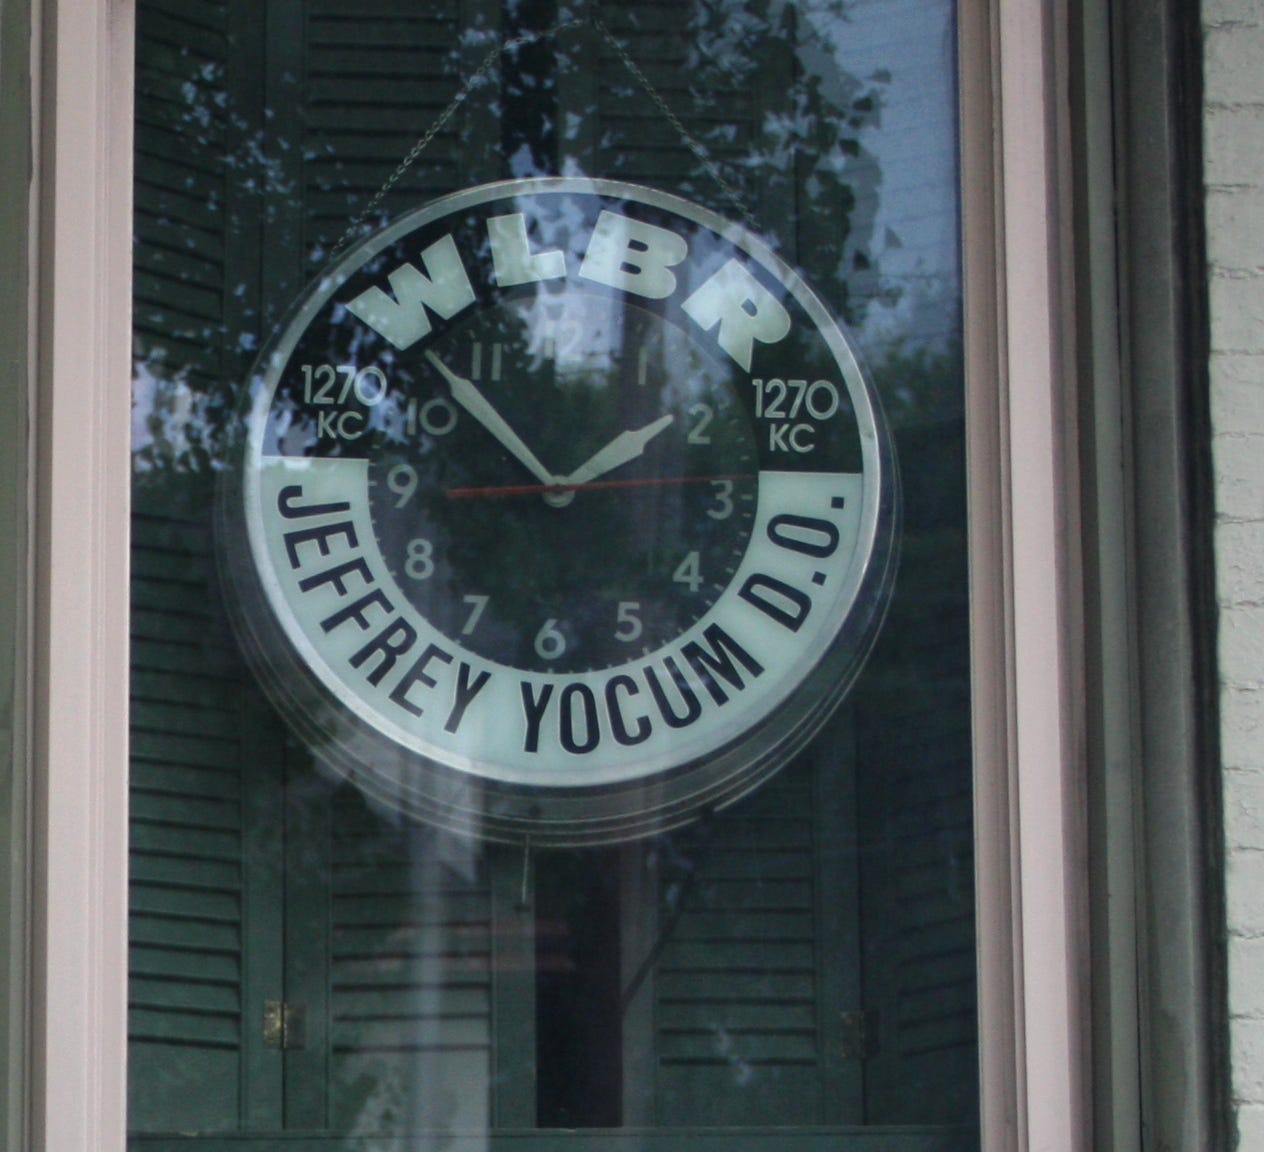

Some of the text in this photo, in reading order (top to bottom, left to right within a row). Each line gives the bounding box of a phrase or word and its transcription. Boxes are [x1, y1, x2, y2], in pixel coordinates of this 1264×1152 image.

[344, 210, 792, 373] WLBR
[301, 364, 387, 405] 1270
[751, 378, 839, 420] 1270
[318, 411, 363, 440] KC
[404, 397, 458, 435] 10
[687, 404, 713, 446] 2
[768, 423, 816, 453] KC
[386, 463, 419, 509] 9
[708, 478, 734, 520] 3
[404, 539, 434, 580] 8
[672, 551, 704, 592] 4
[277, 484, 846, 755] JEFFREY YOCUM D.O.
[462, 595, 491, 636] 7
[616, 601, 643, 642] 5
[534, 619, 566, 660] 6
